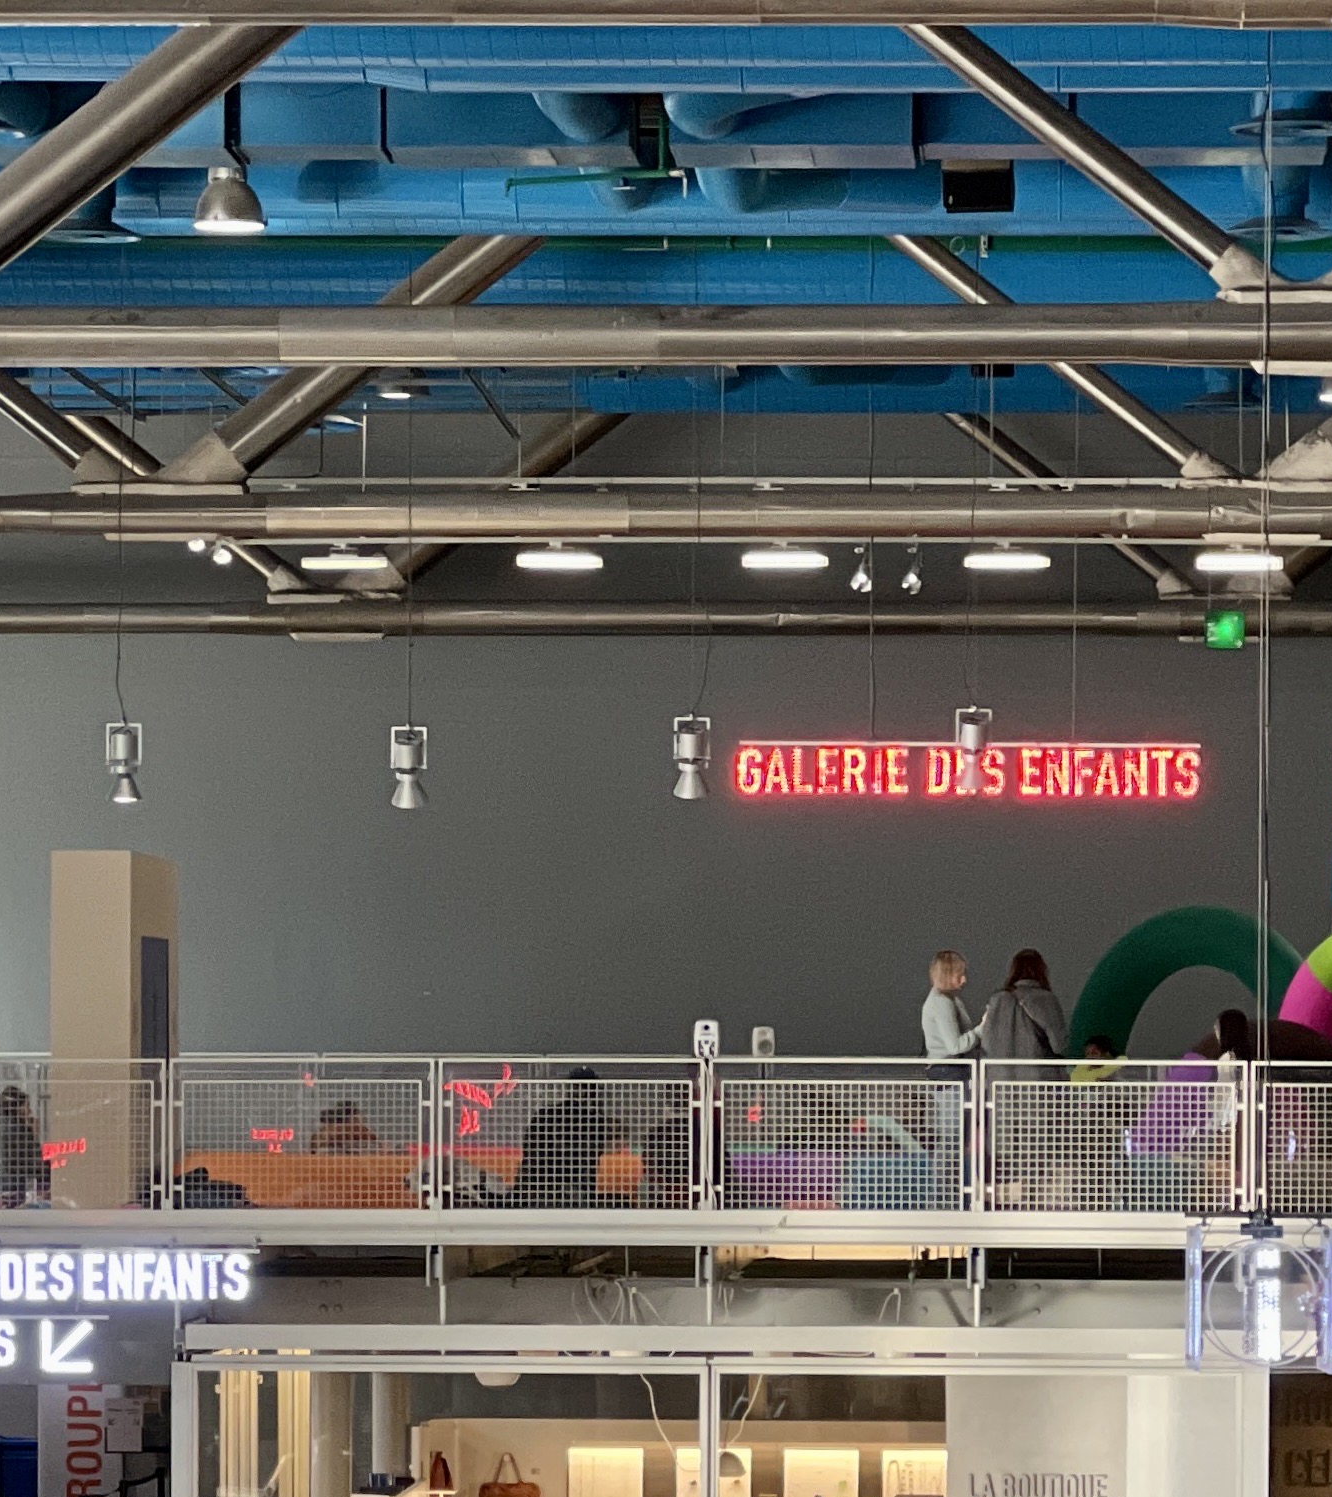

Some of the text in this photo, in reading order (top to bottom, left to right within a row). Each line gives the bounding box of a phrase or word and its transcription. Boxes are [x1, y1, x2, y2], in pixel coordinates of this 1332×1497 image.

[737, 747, 1201, 798] GALERIE DS ENFANTS
[0, 1253, 74, 1300] DES
[82, 1253, 251, 1301] ENFANTS
